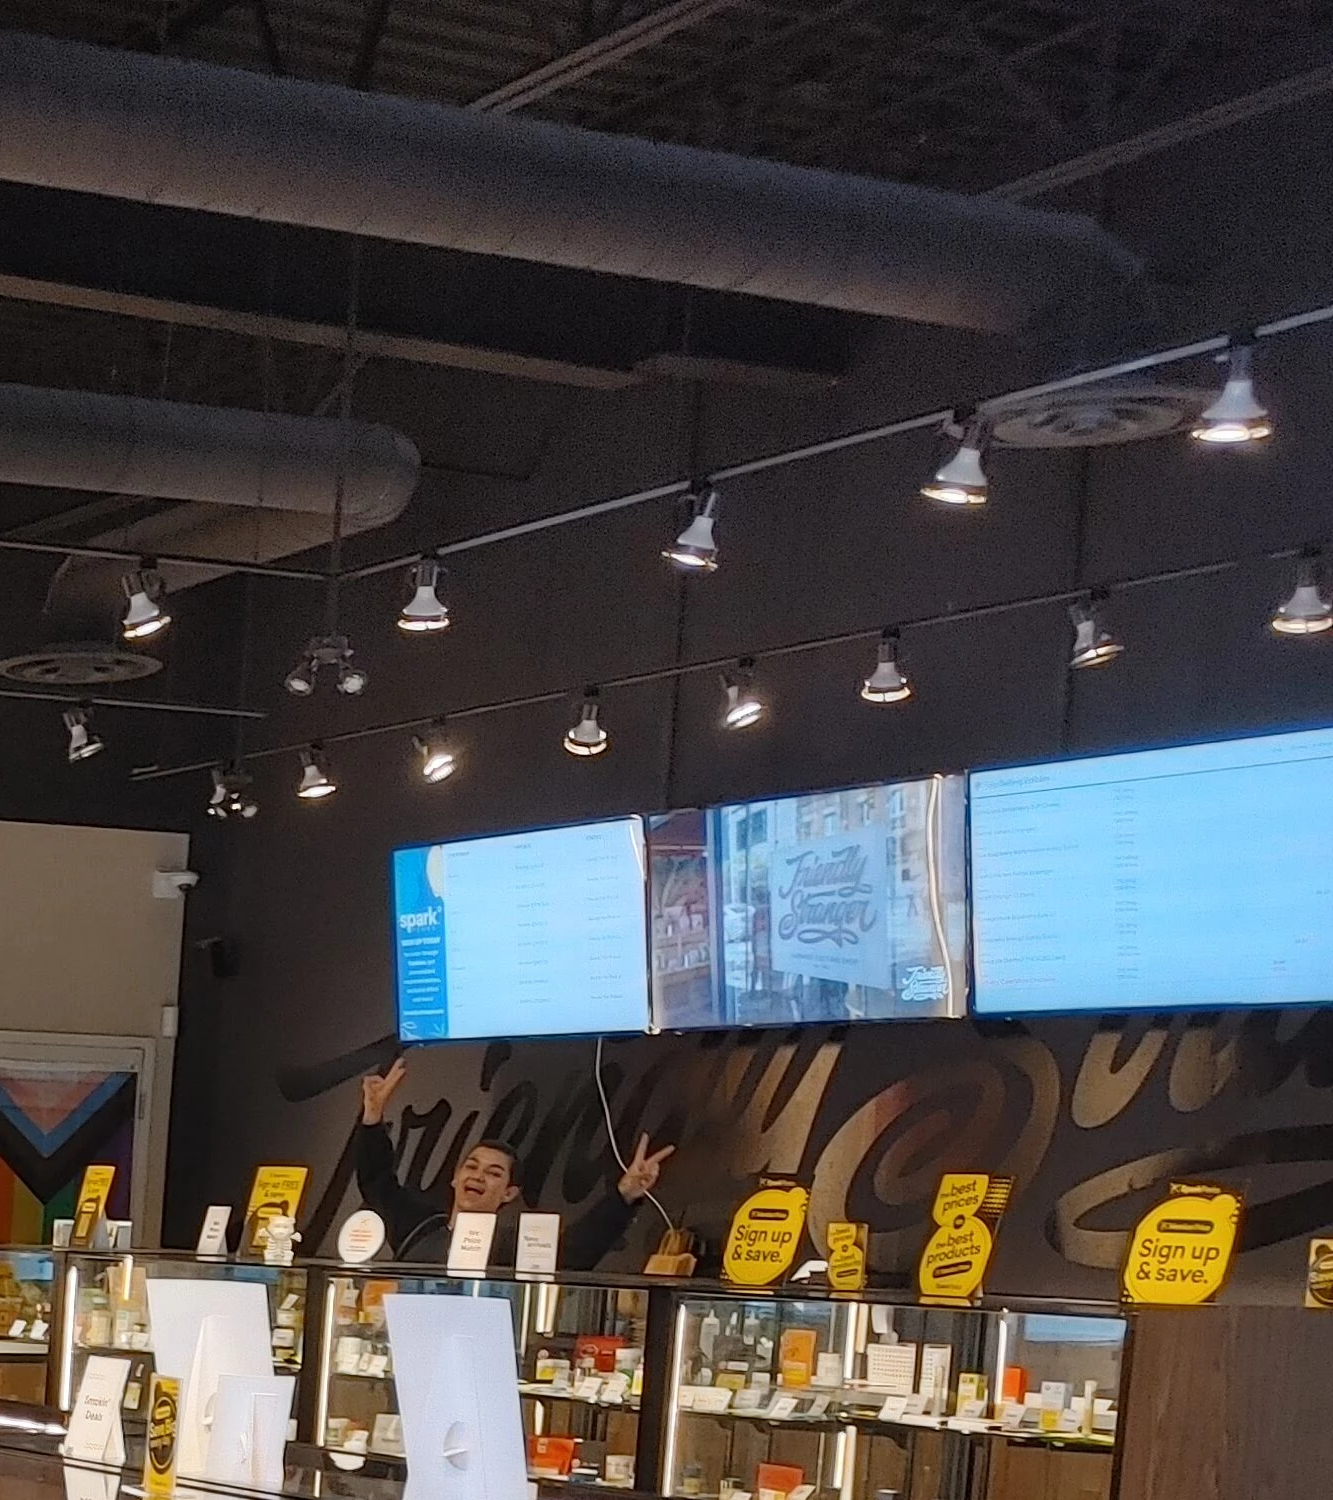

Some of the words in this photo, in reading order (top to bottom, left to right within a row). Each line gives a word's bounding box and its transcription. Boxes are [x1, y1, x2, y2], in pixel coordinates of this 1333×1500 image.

[399, 907, 438, 933] spark
[951, 1179, 977, 1197] best
[942, 1195, 979, 1216] prices
[735, 1225, 764, 1247] Sign
[771, 1232, 793, 1248] up
[947, 1231, 975, 1248] best
[732, 1245, 743, 1261] &
[745, 1250, 783, 1263] save.
[926, 1245, 981, 1268] products
[1139, 1238, 1185, 1265] Sign
[1191, 1247, 1220, 1265] up
[1136, 1262, 1151, 1281] &
[1155, 1268, 1209, 1284] save.
